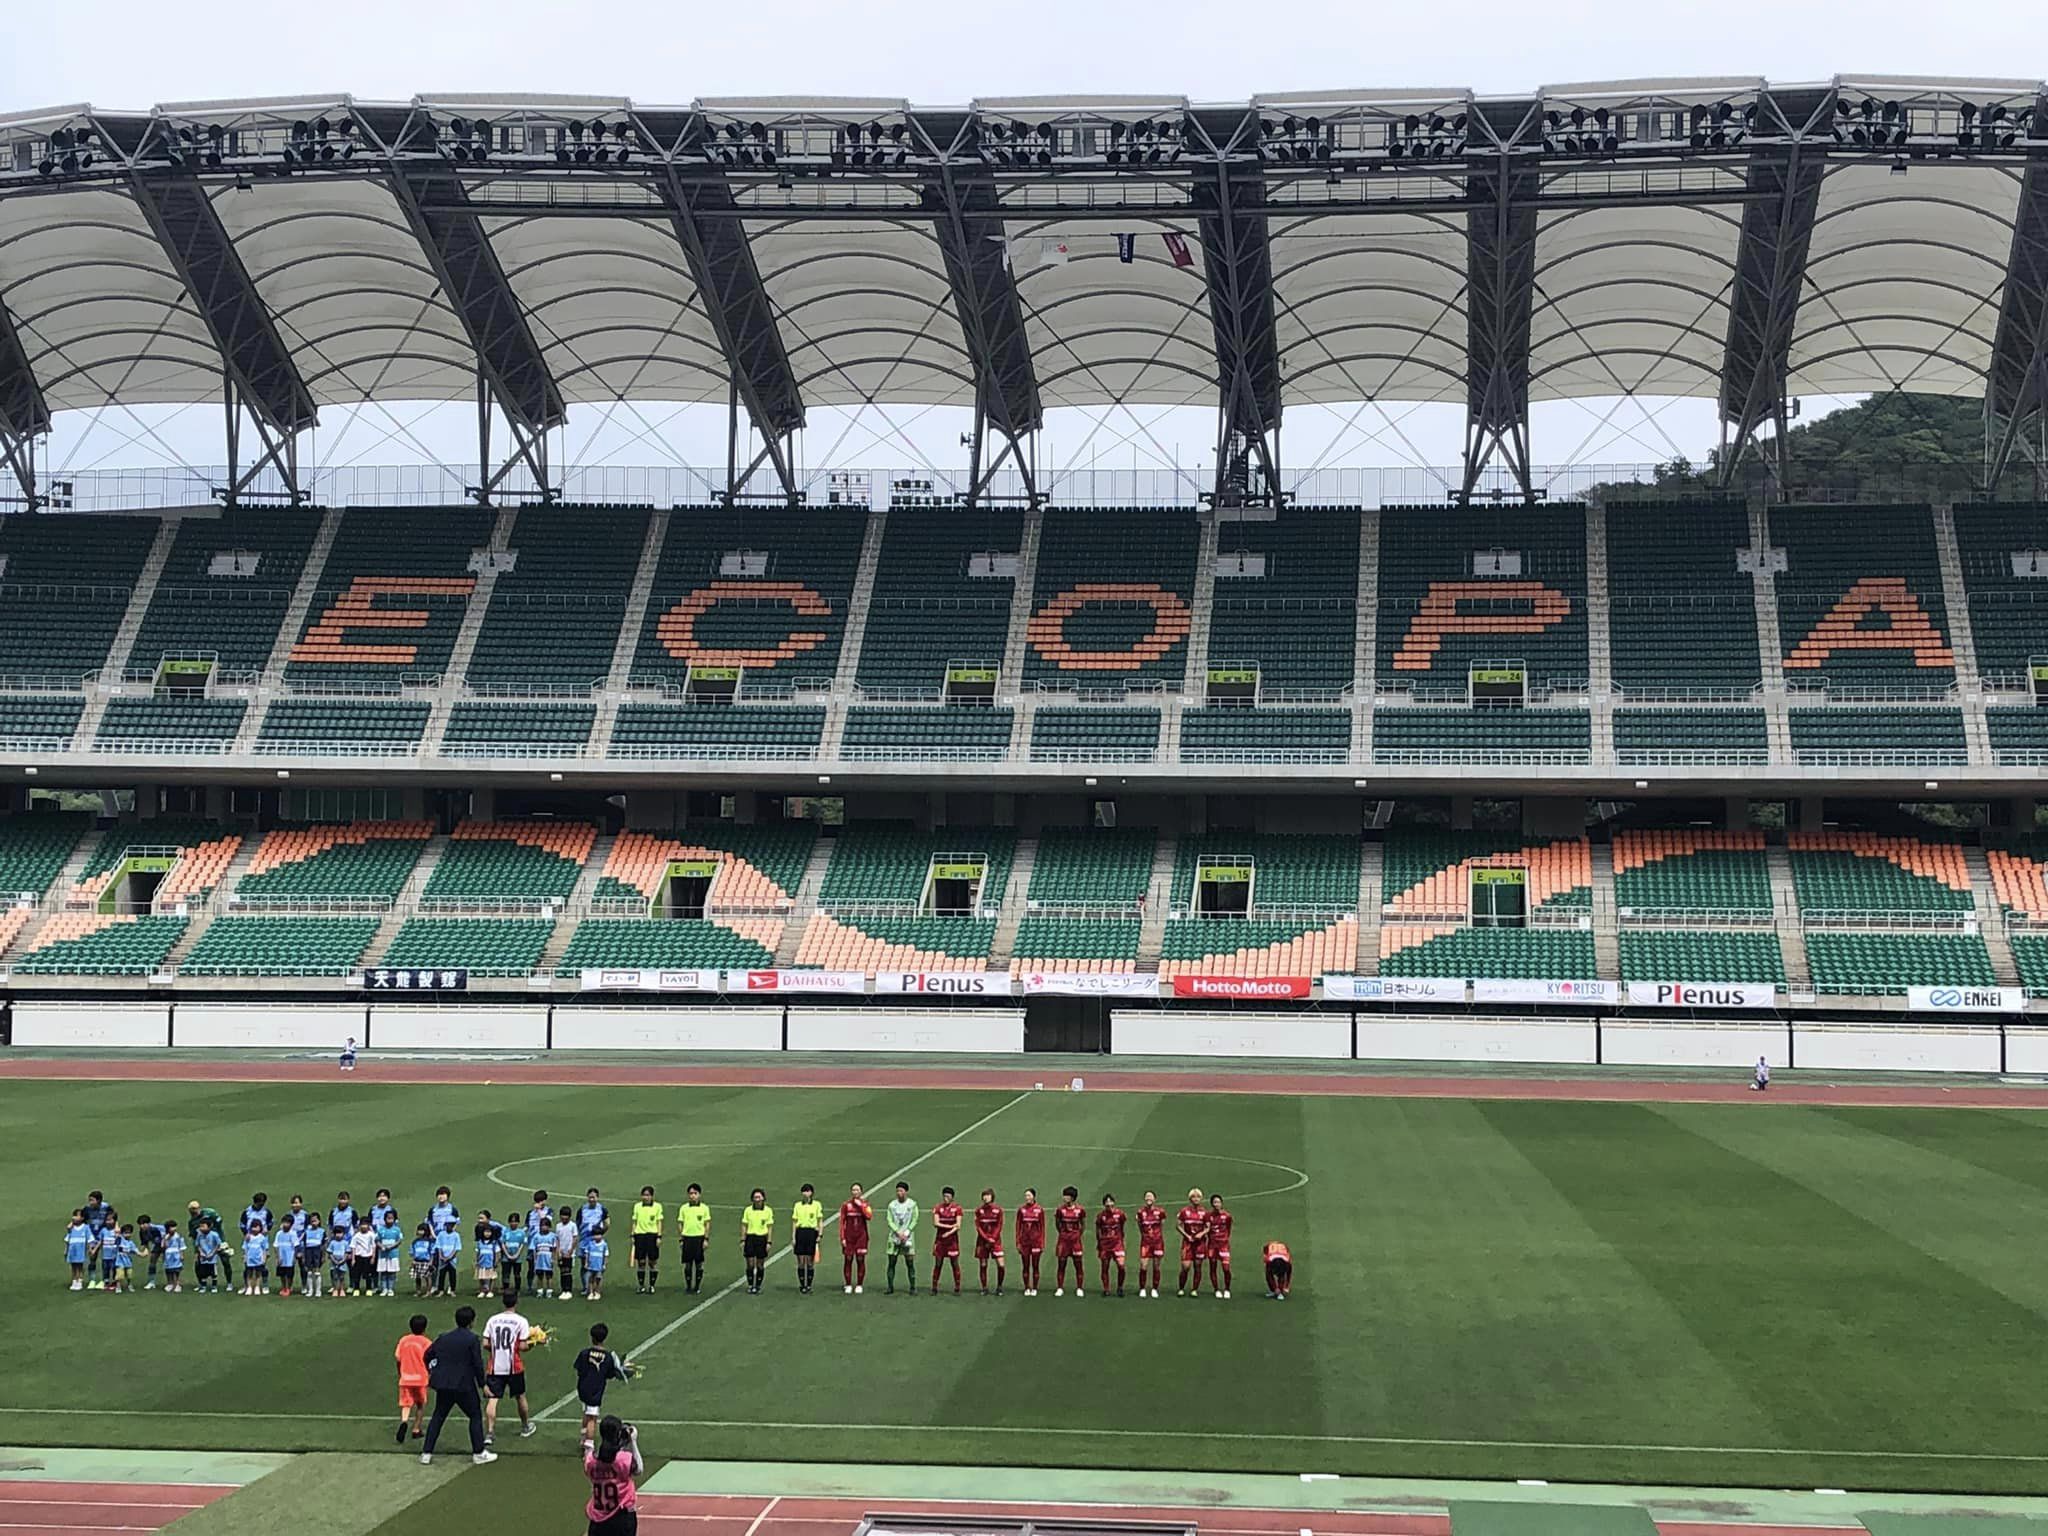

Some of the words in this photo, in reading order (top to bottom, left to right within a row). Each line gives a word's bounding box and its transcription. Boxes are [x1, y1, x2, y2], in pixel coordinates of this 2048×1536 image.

[133, 860, 139, 869] E
[674, 865, 680, 874] E
[939, 867, 946, 876] E
[972, 867, 983, 876] 15
[1205, 870, 1212, 879] E
[1238, 870, 1248, 879] 15
[1477, 872, 1483, 881] E
[1511, 873, 1521, 881] 14
[665, 975, 694, 983] YAYOI
[783, 975, 846, 987] DAIHATSU
[902, 974, 984, 992] Plenus
[1075, 977, 1155, 989] なでしこリーグ
[1192, 979, 1291, 994] HottoMotto
[1384, 982, 1435, 996] 日本トリム
[1657, 985, 1745, 1005] Plenus
[1964, 991, 2002, 1007] ENKEI
[495, 1326, 511, 1349] 10
